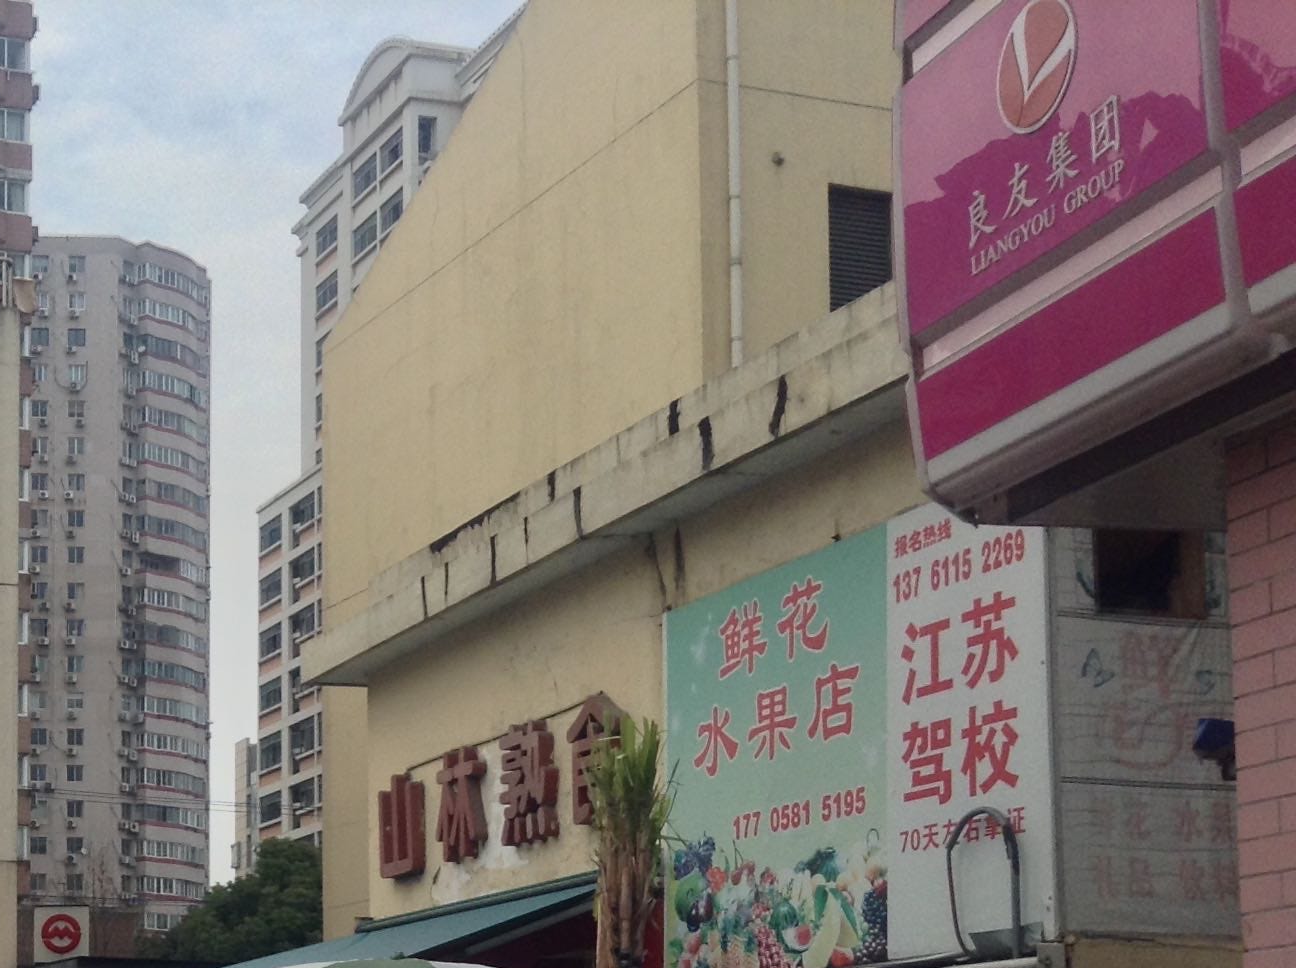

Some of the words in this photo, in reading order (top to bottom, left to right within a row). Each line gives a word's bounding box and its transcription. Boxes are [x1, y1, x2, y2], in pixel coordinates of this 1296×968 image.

[968, 95, 1120, 249] 良友集团
[970, 202, 1056, 276] LIANGYOU
[1063, 158, 1125, 216] GROUP
[892, 565, 922, 604] 137
[930, 548, 972, 592] 6115
[981, 529, 1025, 573] 2269
[894, 518, 952, 558] 报名热线
[718, 575, 829, 680] 鲜花
[900, 591, 1019, 706] 江苏
[693, 663, 860, 776] 水果店
[901, 701, 1020, 804] 驾校
[732, 810, 761, 841] 177
[769, 799, 811, 833] 0581
[821, 787, 867, 822] 5195
